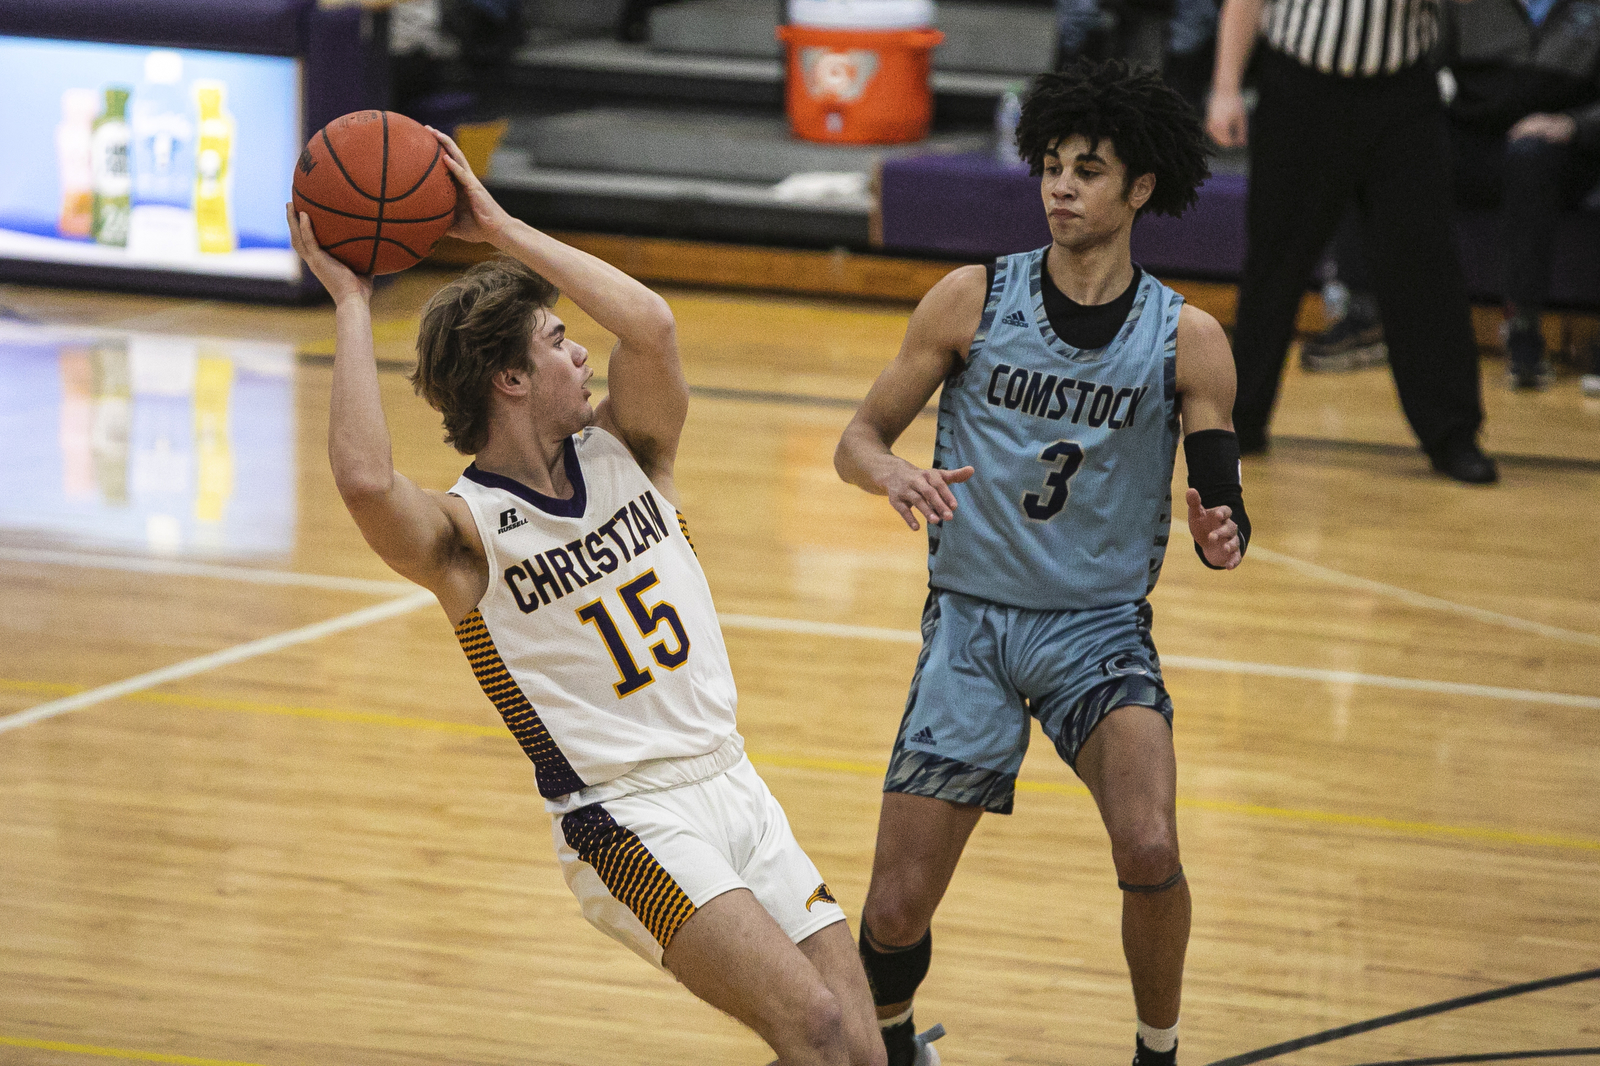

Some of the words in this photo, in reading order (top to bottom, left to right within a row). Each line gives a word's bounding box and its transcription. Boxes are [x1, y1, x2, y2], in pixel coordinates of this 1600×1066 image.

[987, 364, 1147, 430] COMSTOCK
[1022, 439, 1084, 521] 3
[498, 518, 528, 534] RUSSELL
[504, 490, 669, 614] CHRISTIAN
[575, 567, 691, 699] 15
